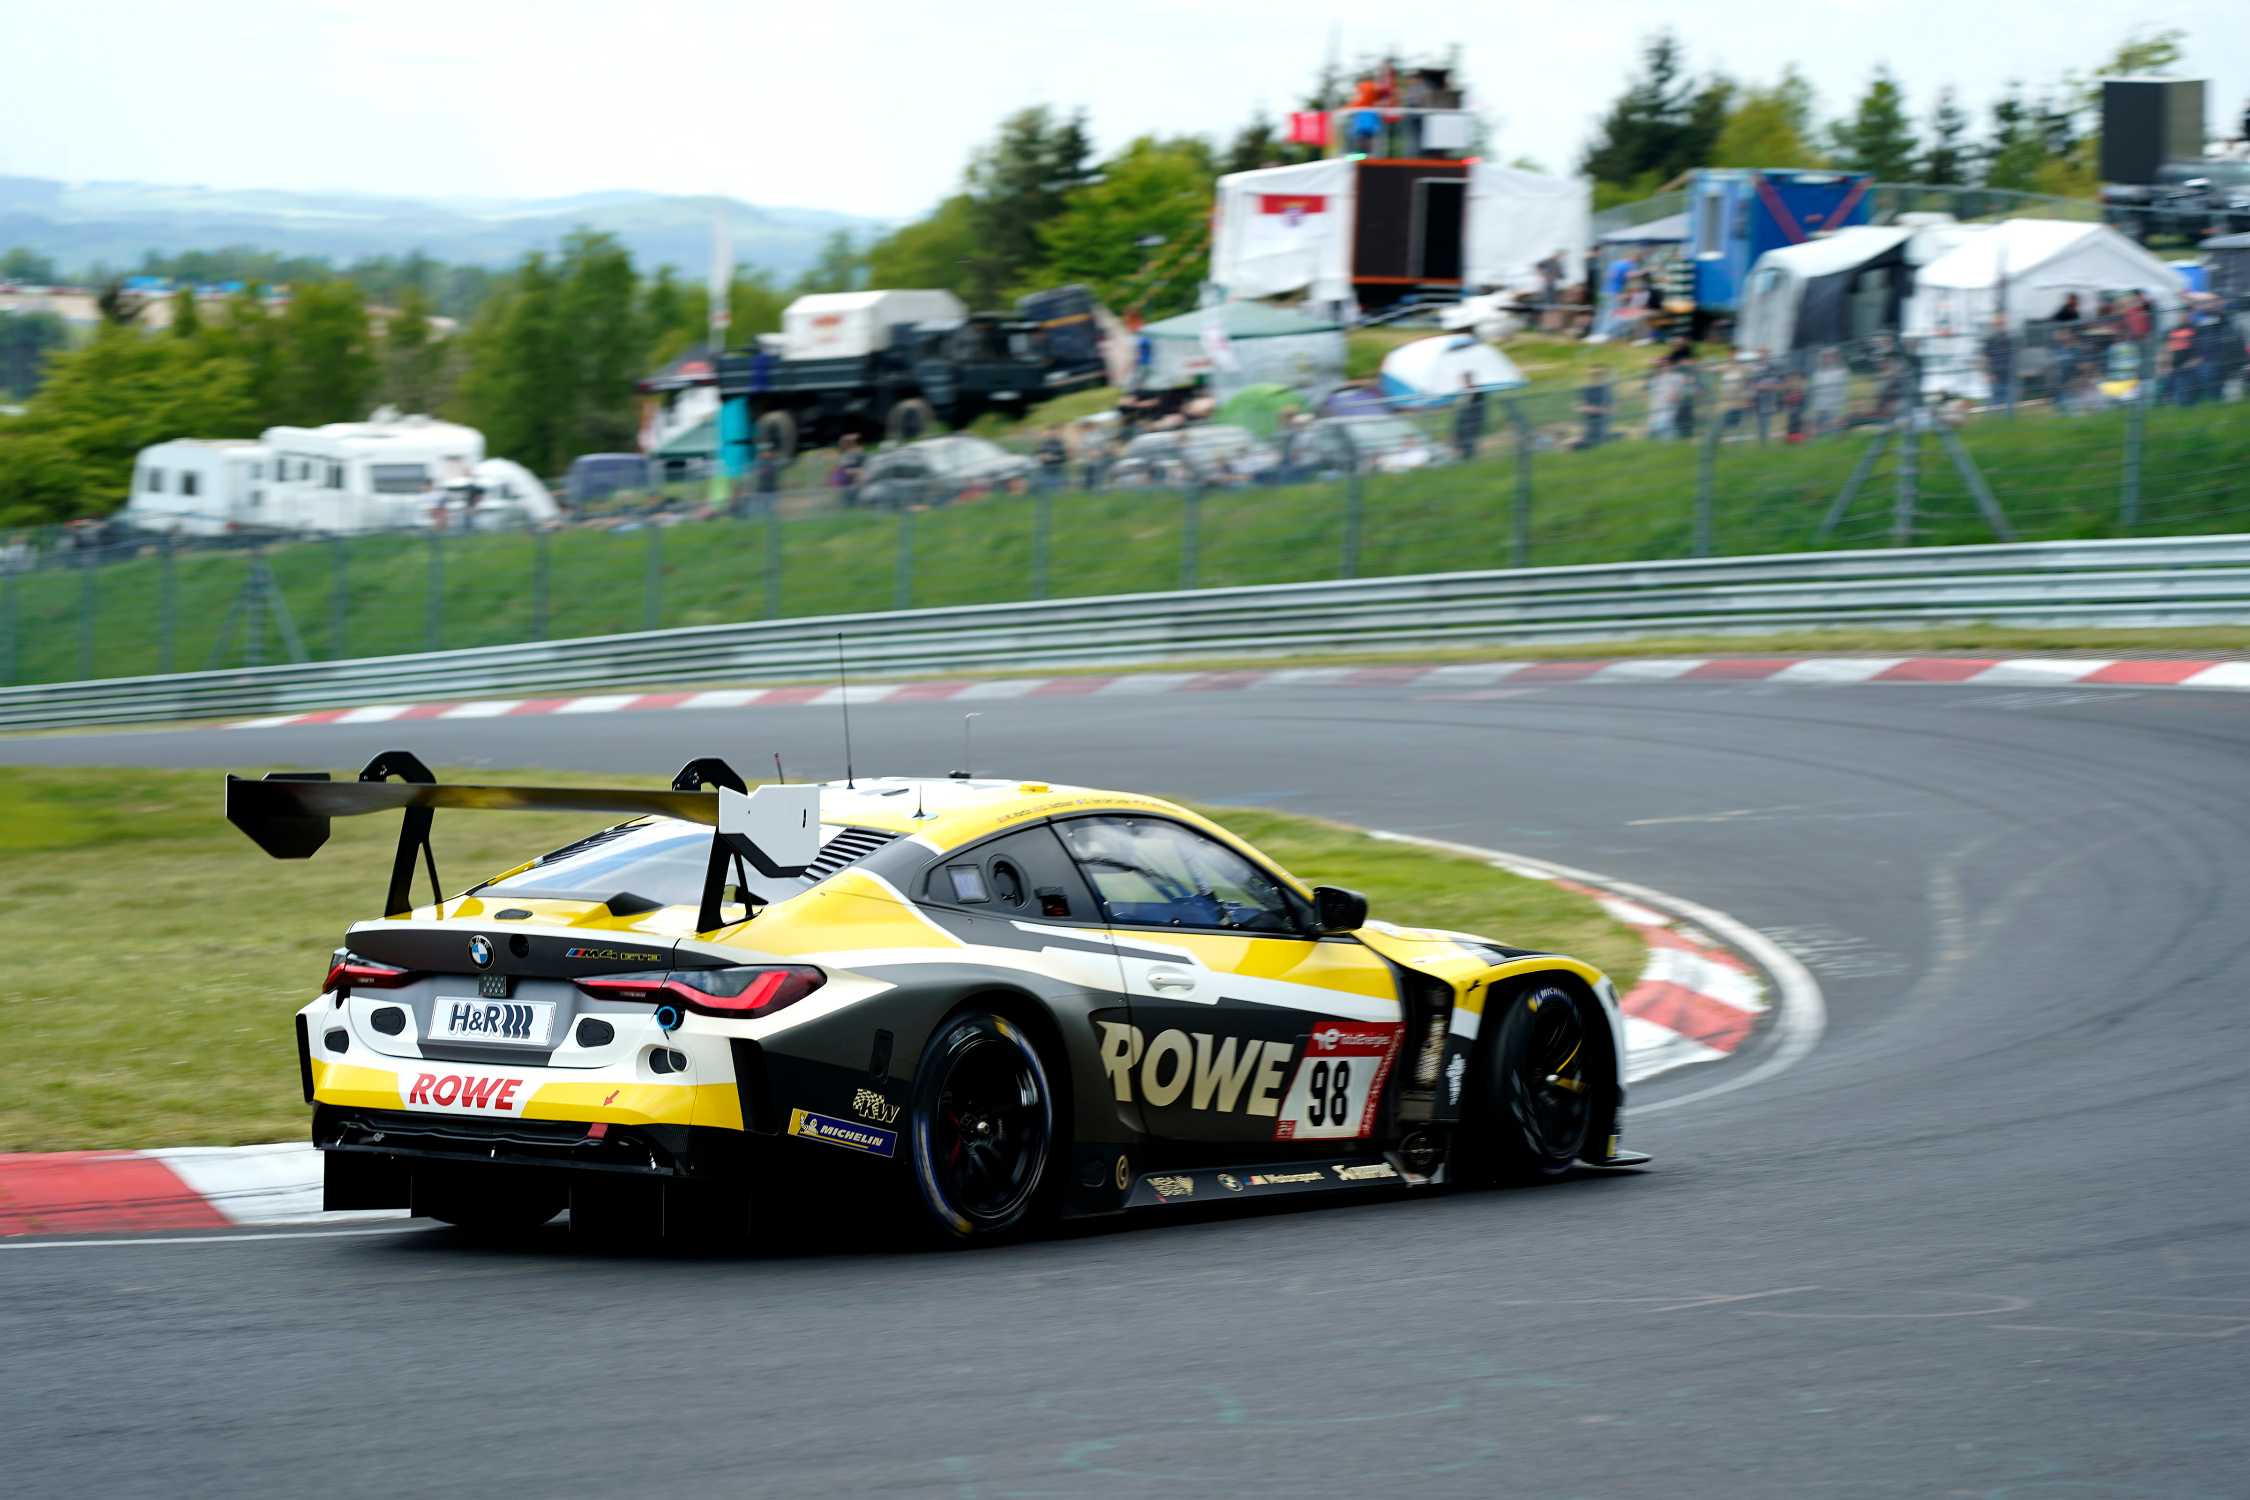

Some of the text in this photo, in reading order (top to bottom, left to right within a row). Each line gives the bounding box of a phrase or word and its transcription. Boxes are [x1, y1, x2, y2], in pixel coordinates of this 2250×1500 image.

[449, 1004, 501, 1033] H&R
[1096, 1021, 1295, 1117] ROWE
[409, 1072, 524, 1111] ROWE
[1308, 1060, 1350, 1127] 98
[858, 1099, 900, 1124] KW
[819, 1124, 884, 1147] MICHELIN
